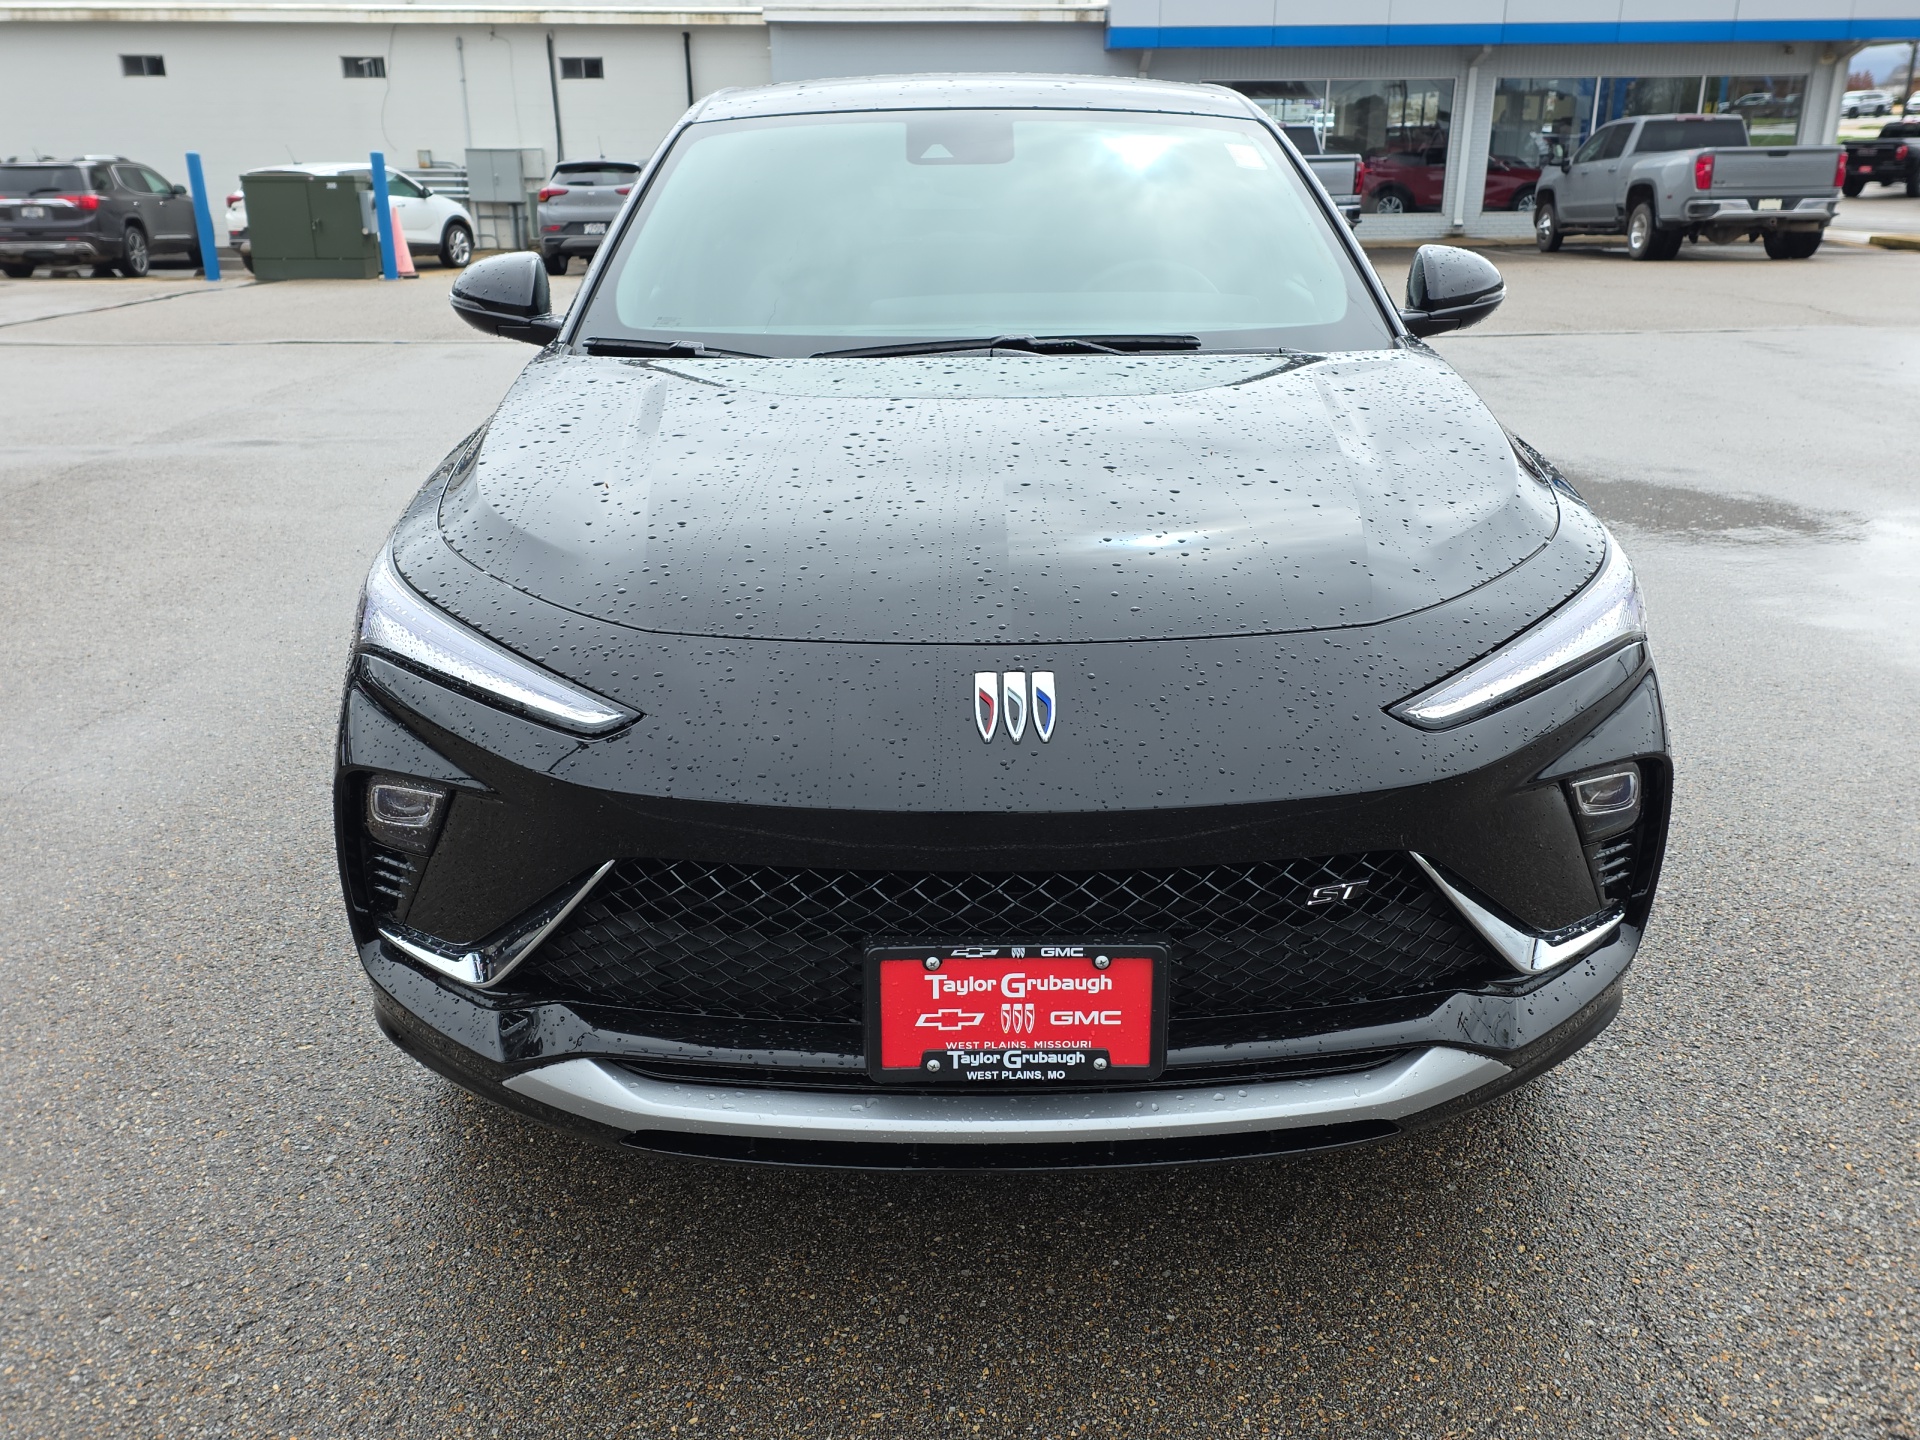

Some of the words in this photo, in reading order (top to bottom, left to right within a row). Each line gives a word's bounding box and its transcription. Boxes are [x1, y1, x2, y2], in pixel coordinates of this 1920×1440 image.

[1040, 947, 1084, 957] GMC
[924, 974, 997, 1000] Taylor
[1000, 972, 1113, 998] Grubaugh
[1050, 1010, 1122, 1025] GMC
[945, 1041, 979, 1050] WEST
[1033, 1040, 1092, 1049] MISSOURI
[946, 1050, 1000, 1070] Taylor
[1002, 1050, 1086, 1069] Grubaugh
[966, 1070, 999, 1080] WEST
[1001, 1070, 1045, 1080] PLAINS,
[1047, 1070, 1066, 1080] MO
